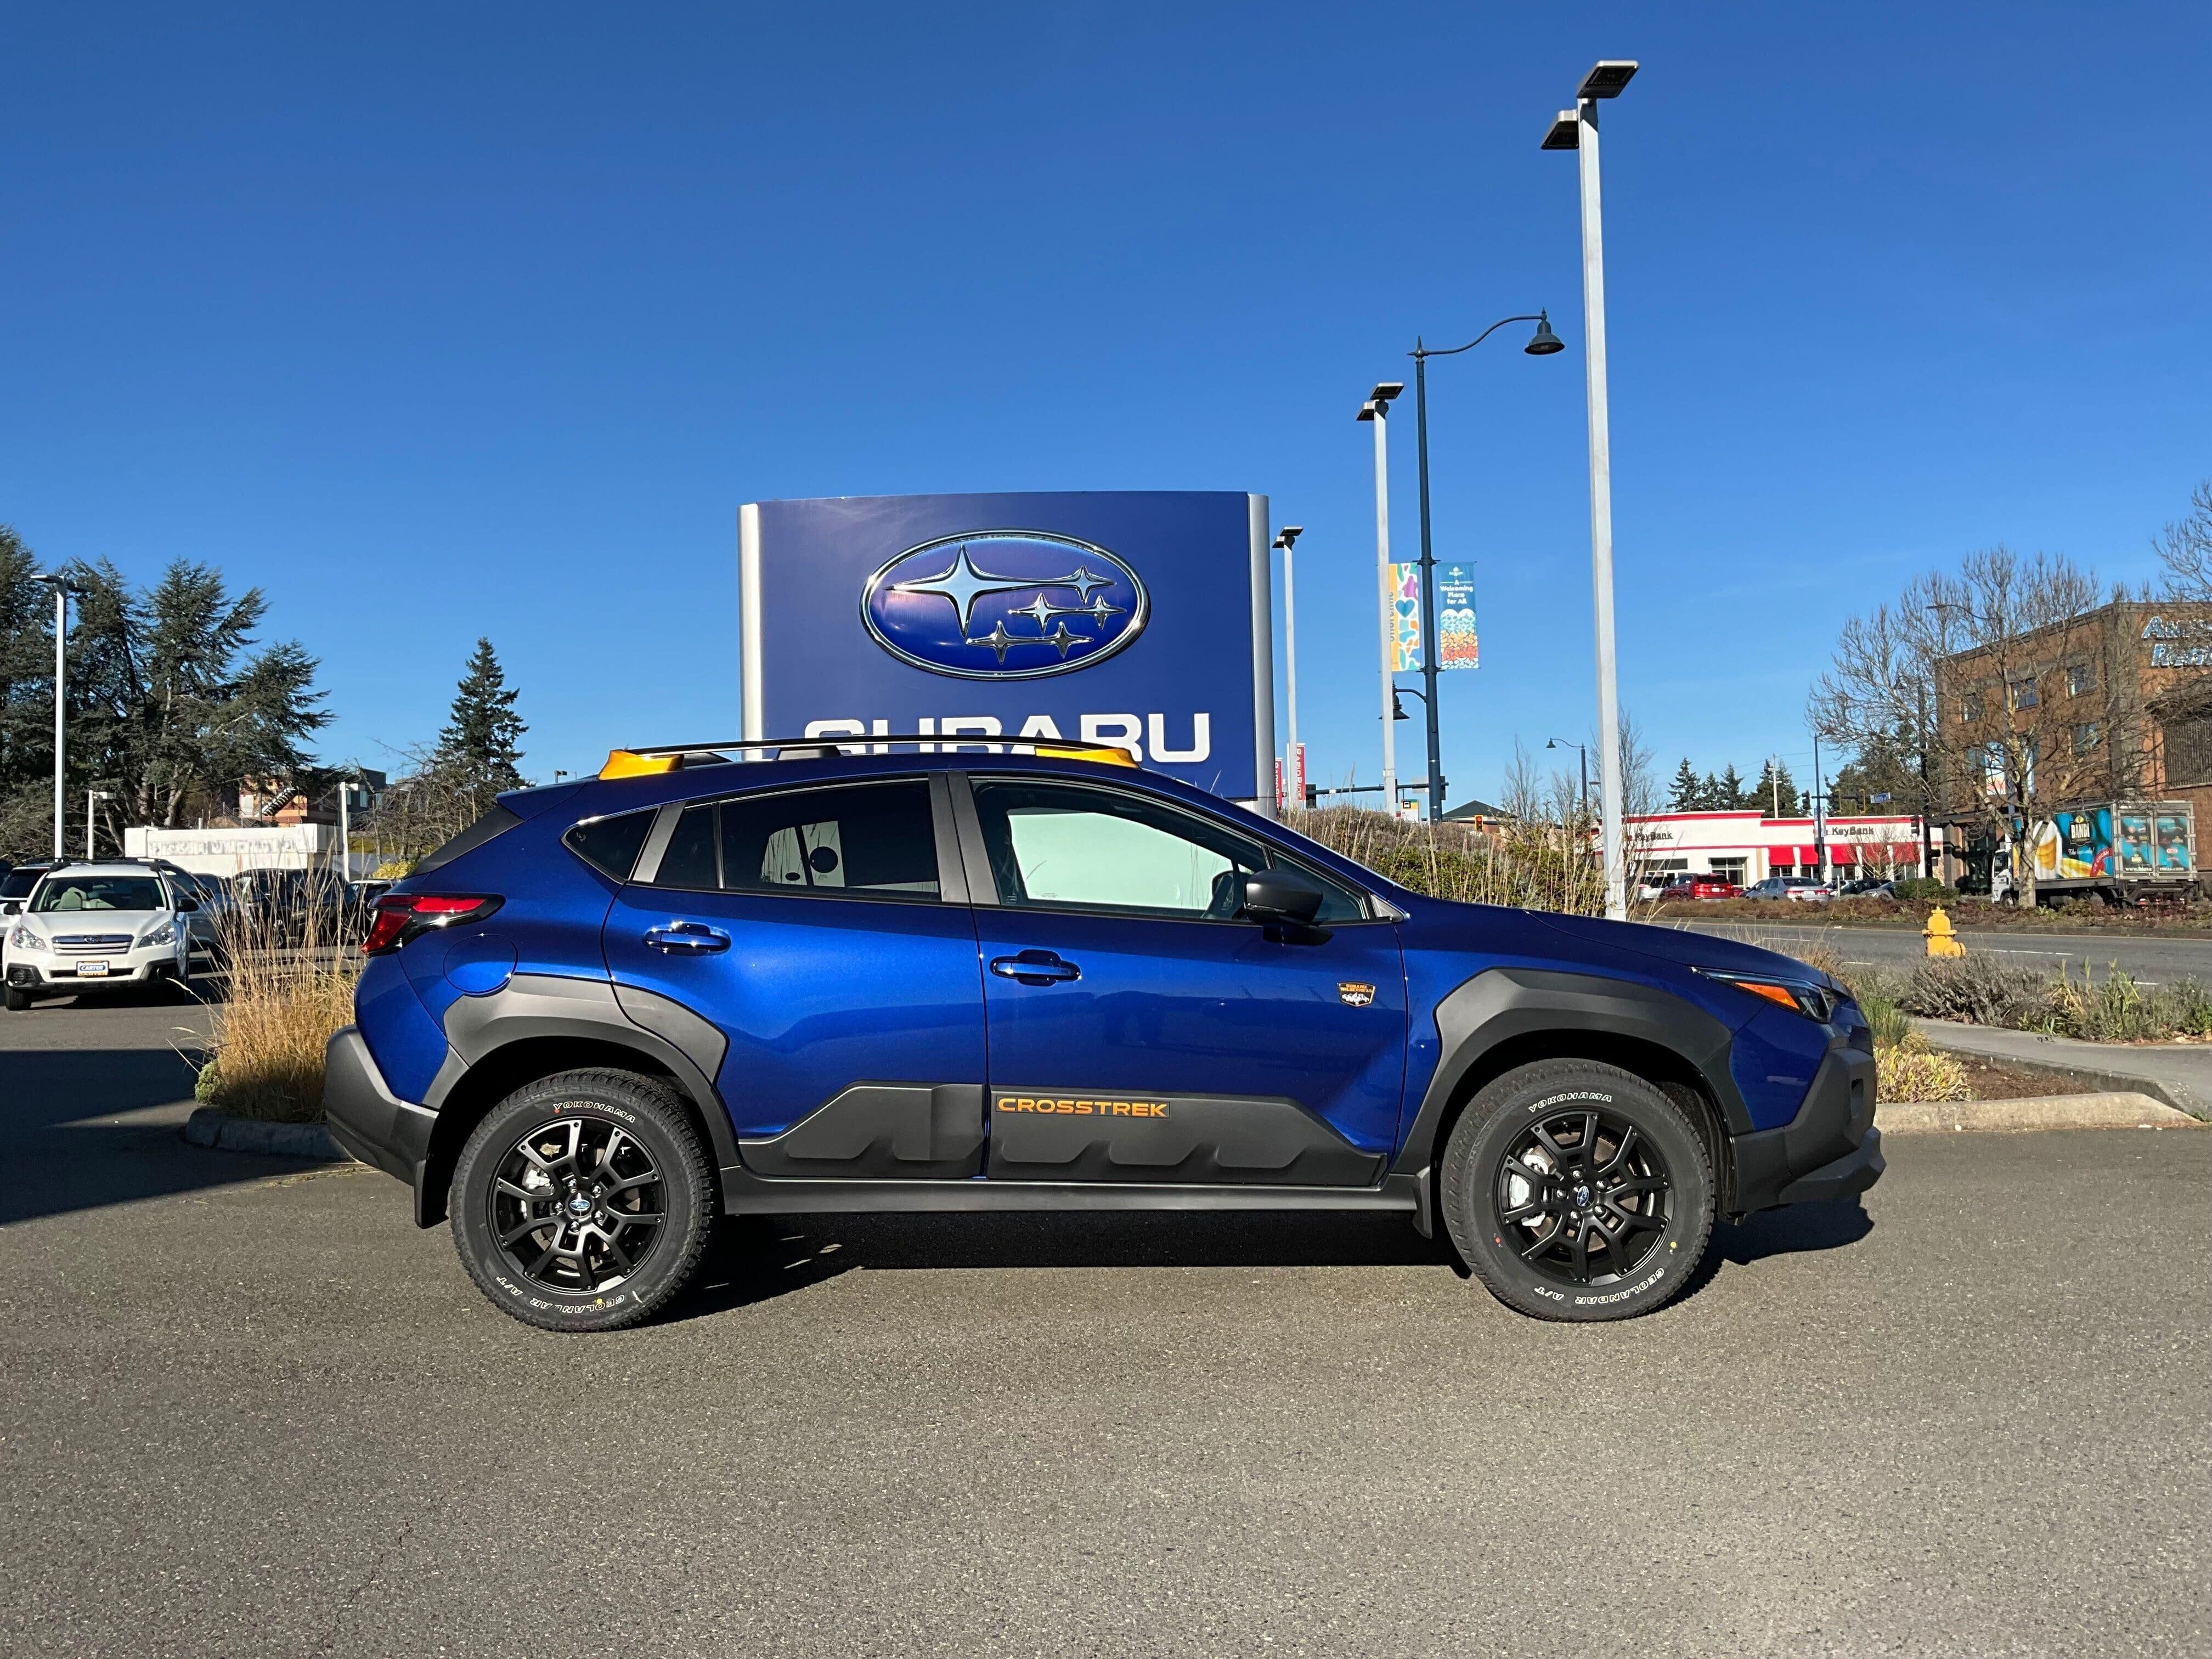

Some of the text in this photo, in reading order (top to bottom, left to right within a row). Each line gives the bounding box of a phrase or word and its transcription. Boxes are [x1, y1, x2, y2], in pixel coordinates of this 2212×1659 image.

[804, 713, 1210, 762] SUBARU
[1635, 831, 1673, 842] KeyBank
[1832, 826, 1874, 837] KeyBank
[553, 1101, 636, 1123] YOKOHAMA
[998, 1098, 1167, 1117] CROSSTREK
[1528, 1092, 1612, 1113] YOKOHAMA
[496, 1277, 523, 1296] A/T
[1534, 1268, 1664, 1304] GEOLANDAR A/T
